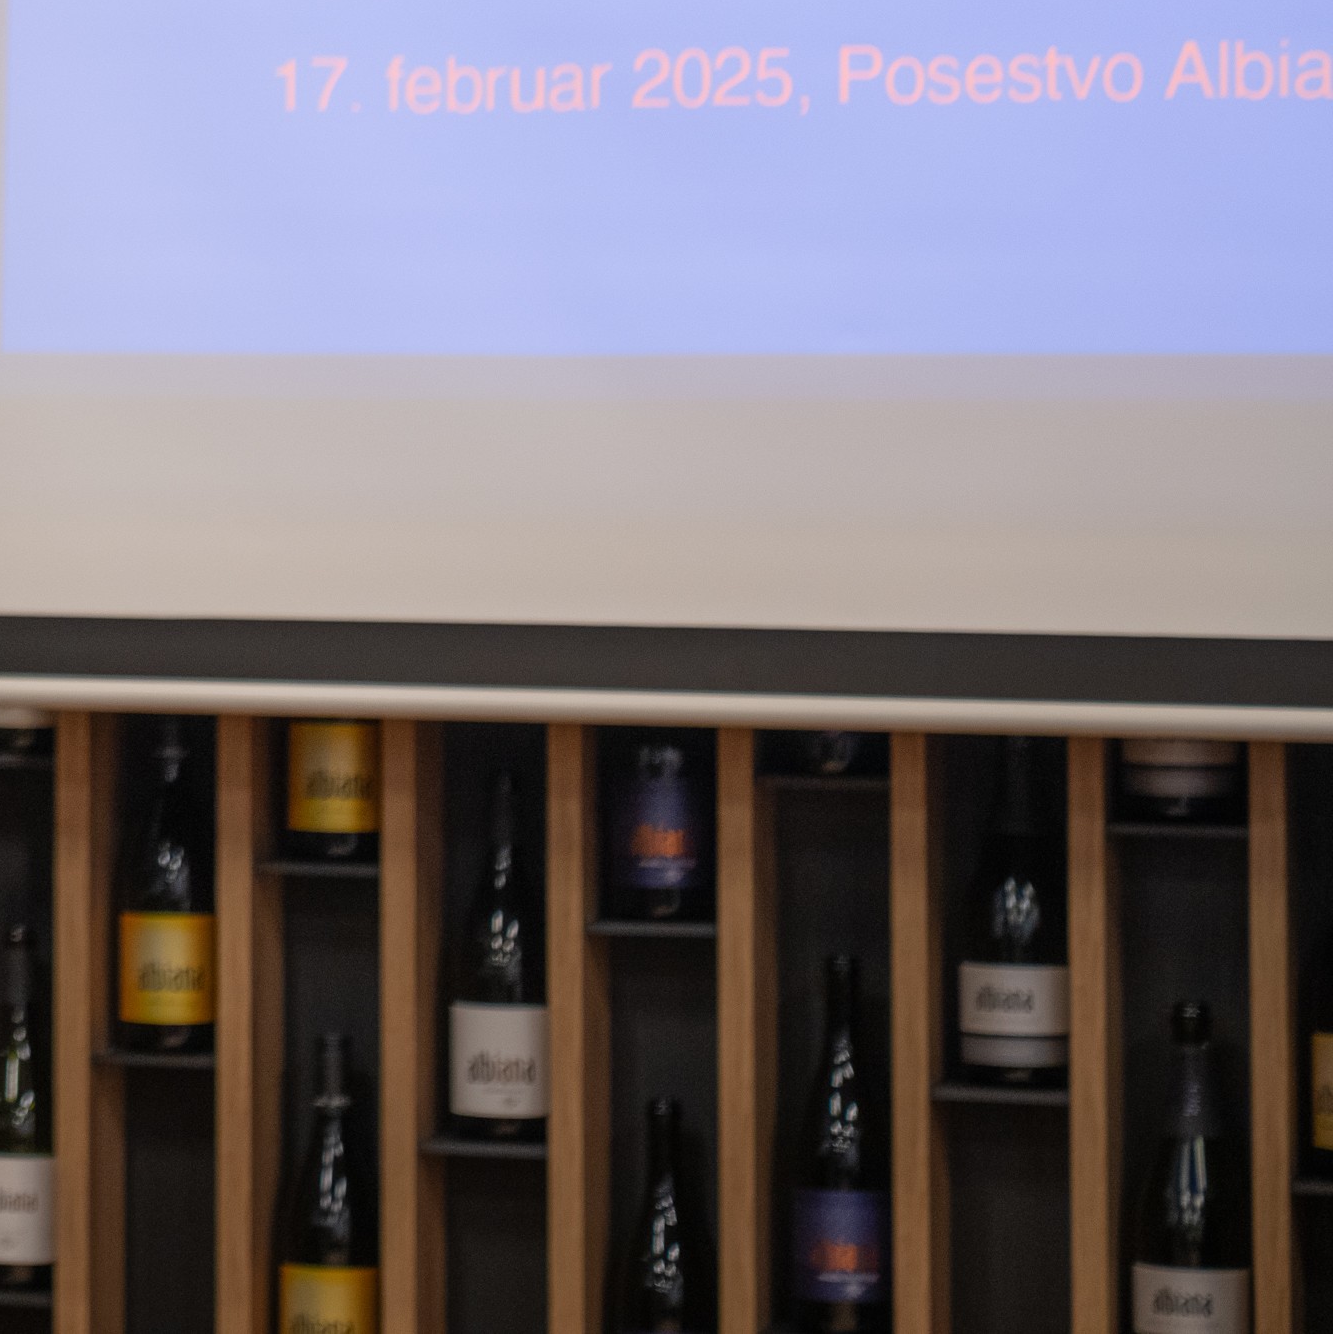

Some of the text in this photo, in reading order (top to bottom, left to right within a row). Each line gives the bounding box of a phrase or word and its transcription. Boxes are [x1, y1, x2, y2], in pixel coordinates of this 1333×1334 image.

[275, 37, 1333, 117] 17. februar 2025, Posestvo Albia
